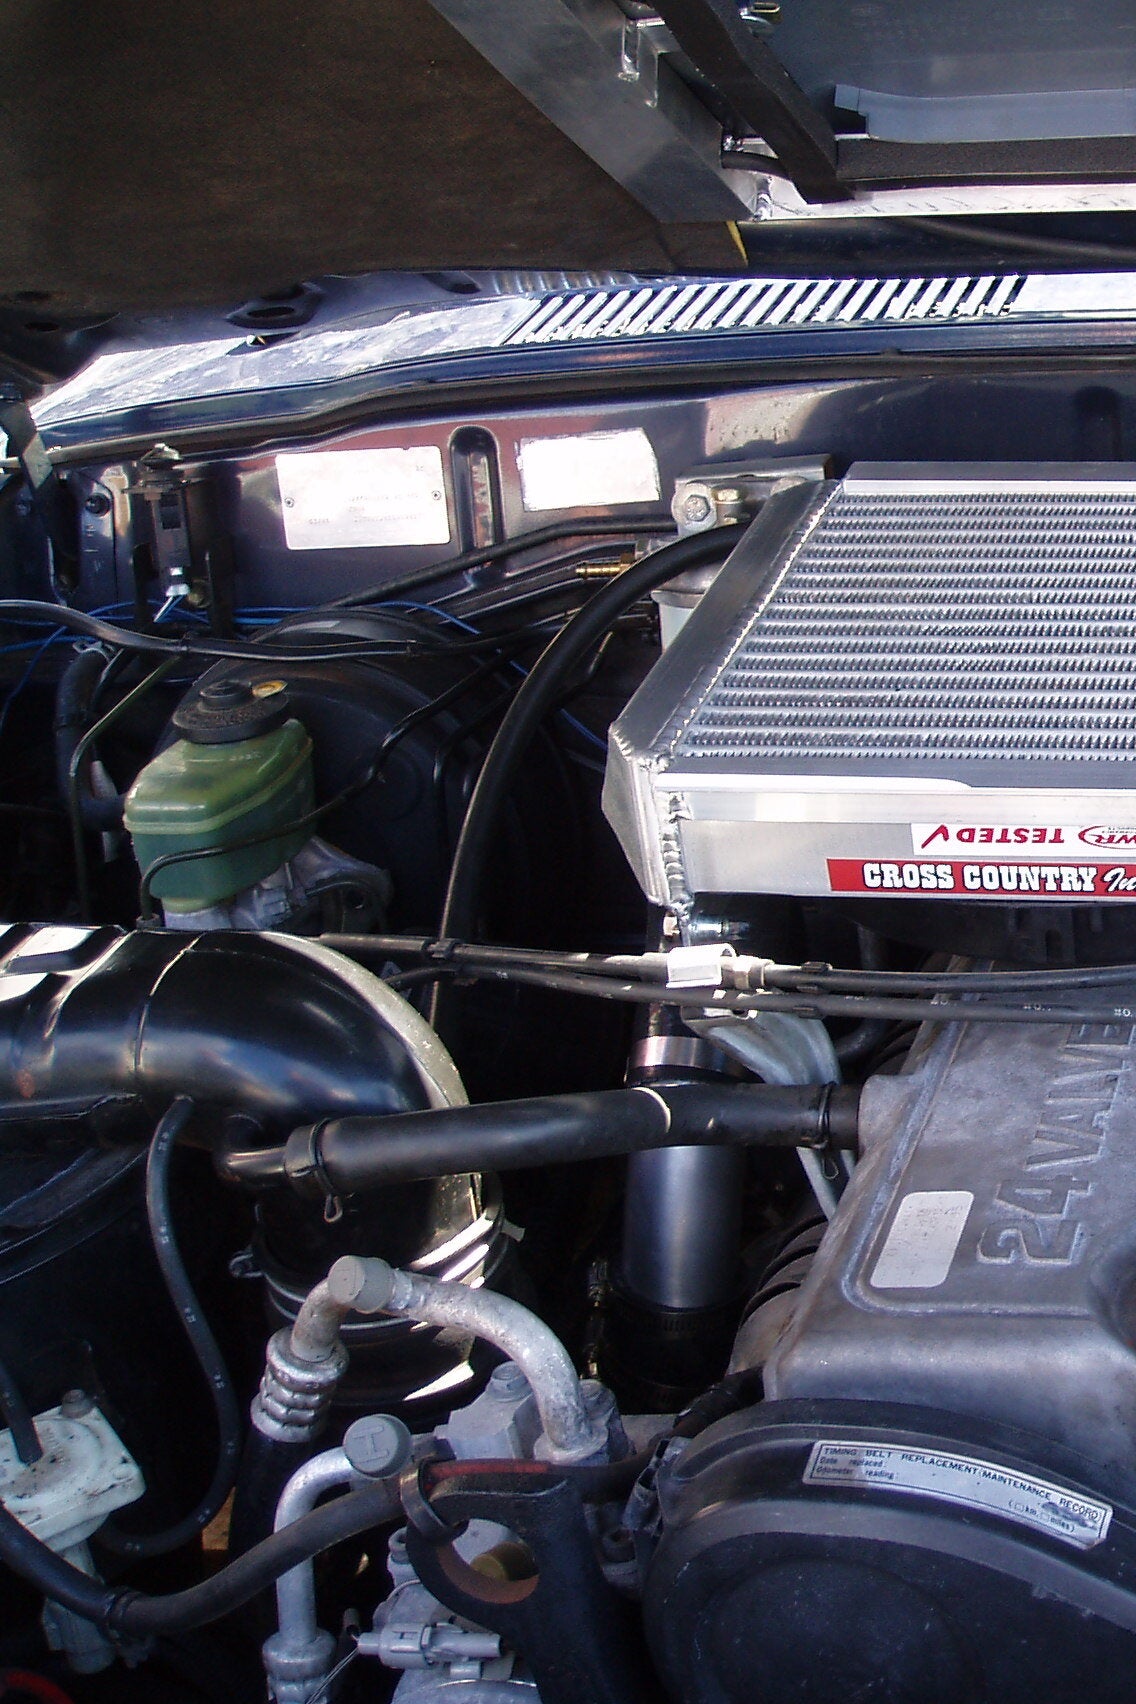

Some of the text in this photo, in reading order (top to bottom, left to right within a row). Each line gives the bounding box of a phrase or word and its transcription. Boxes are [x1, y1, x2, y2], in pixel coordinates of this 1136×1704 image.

[956, 826, 1064, 845] TESTED
[862, 862, 954, 890] CROSS
[963, 865, 1098, 892] COUNTRY
[823, 1446, 858, 1457] TIMING
[865, 1449, 892, 1459] BELT
[901, 1453, 978, 1475] REPLACEMENT
